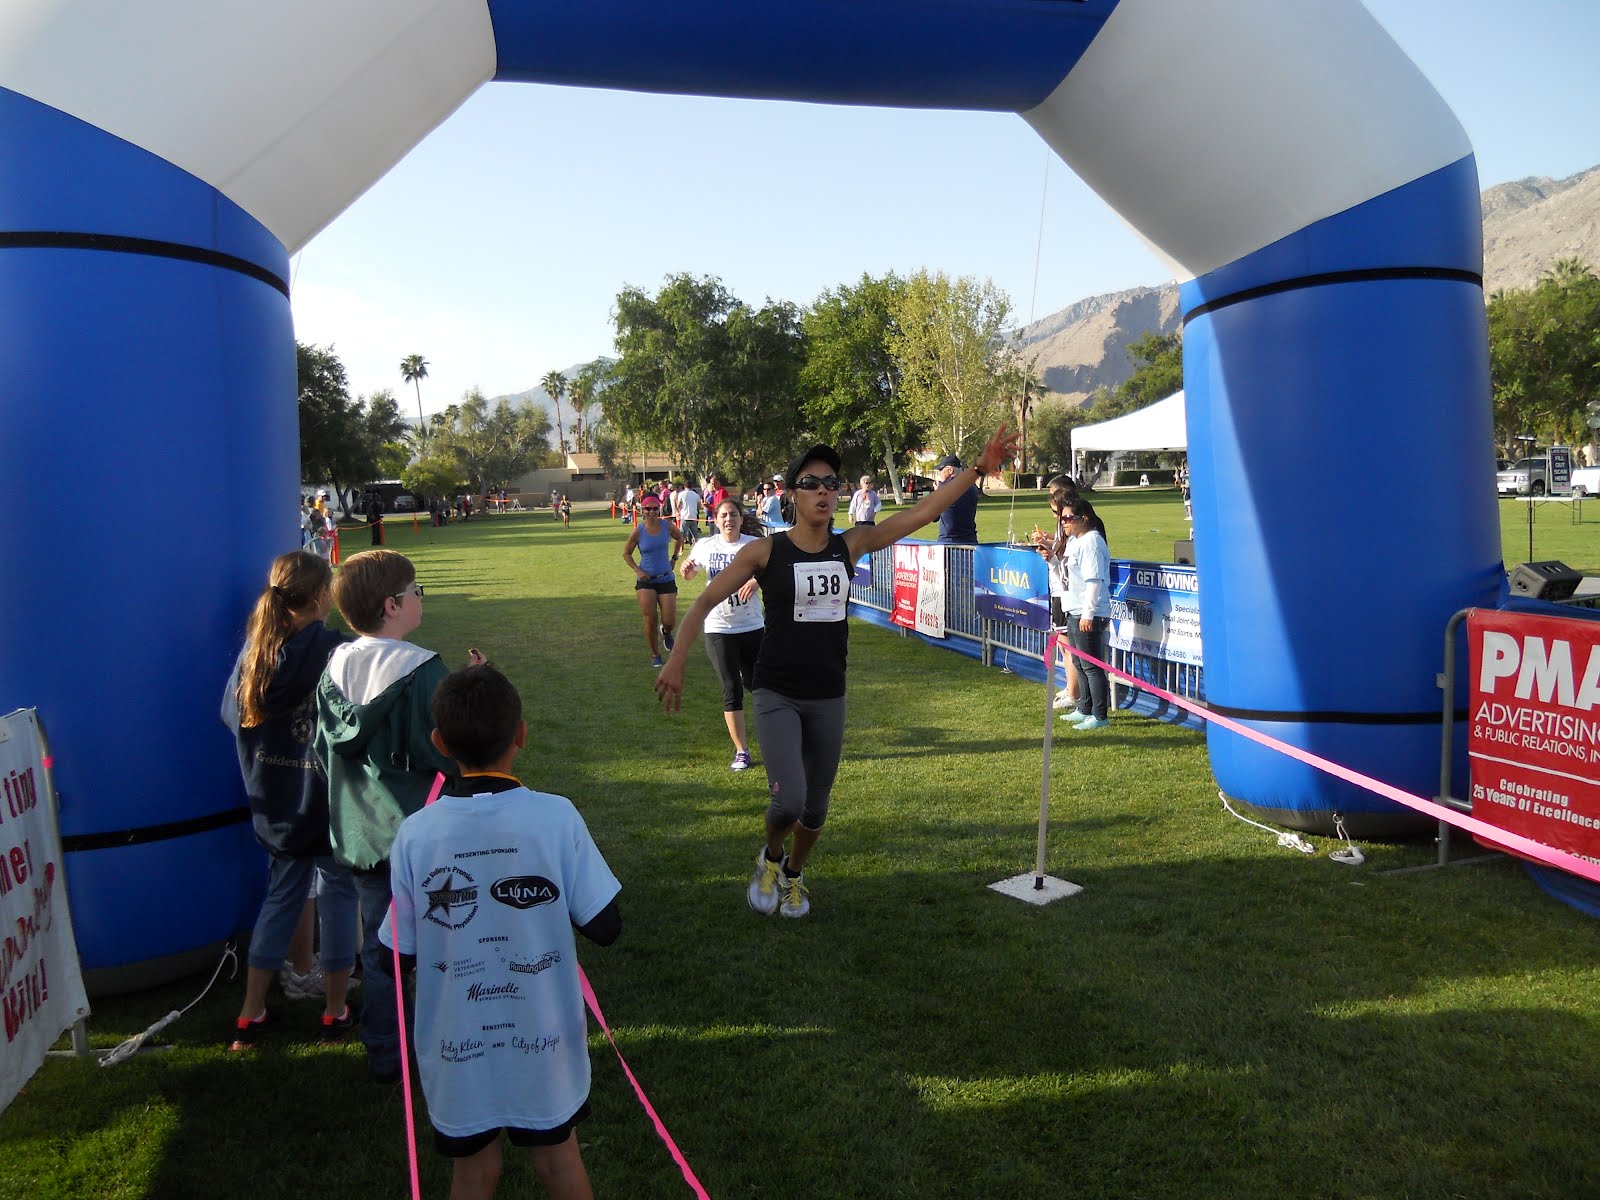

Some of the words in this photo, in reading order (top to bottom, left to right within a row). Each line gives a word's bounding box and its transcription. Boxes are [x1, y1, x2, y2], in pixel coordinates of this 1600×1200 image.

[709, 553, 728, 561] JUST
[807, 574, 840, 596] 138
[990, 567, 1030, 590] LUNA
[1136, 570, 1155, 586] GET
[1157, 573, 1198, 591] MOVING
[1480, 630, 1600, 711] PMA
[1475, 701, 1600, 745] ADVERTISIN
[1474, 725, 1482, 738] &
[1485, 727, 1519, 745] PUBLIC
[1522, 735, 1587, 762] RELATIONS,
[1590, 749, 1600, 763] IN
[0, 767, 37, 824] ting
[1500, 778, 1568, 807] Celebrating
[1473, 784, 1484, 800] 25
[1486, 788, 1516, 808] Years
[1518, 798, 1530, 811] Of
[1533, 802, 1600, 830] Excellence
[455, 850, 489, 859] PRESENTING
[491, 848, 518, 856] SPONSORS
[422, 877, 431, 888] The
[429, 866, 451, 878] Valley's
[452, 866, 474, 883] Premier
[497, 886, 553, 900] LUNA
[453, 958, 472, 966] DESERT
[454, 961, 485, 972] VETERINARY
[454, 967, 486, 978] SPECIALISTS
[467, 982, 519, 1002] Marinello
[482, 1023, 515, 1031] BENEFITING
[460, 1038, 485, 1054] Klein
[512, 1036, 529, 1054] City
[530, 1037, 539, 1053] of
